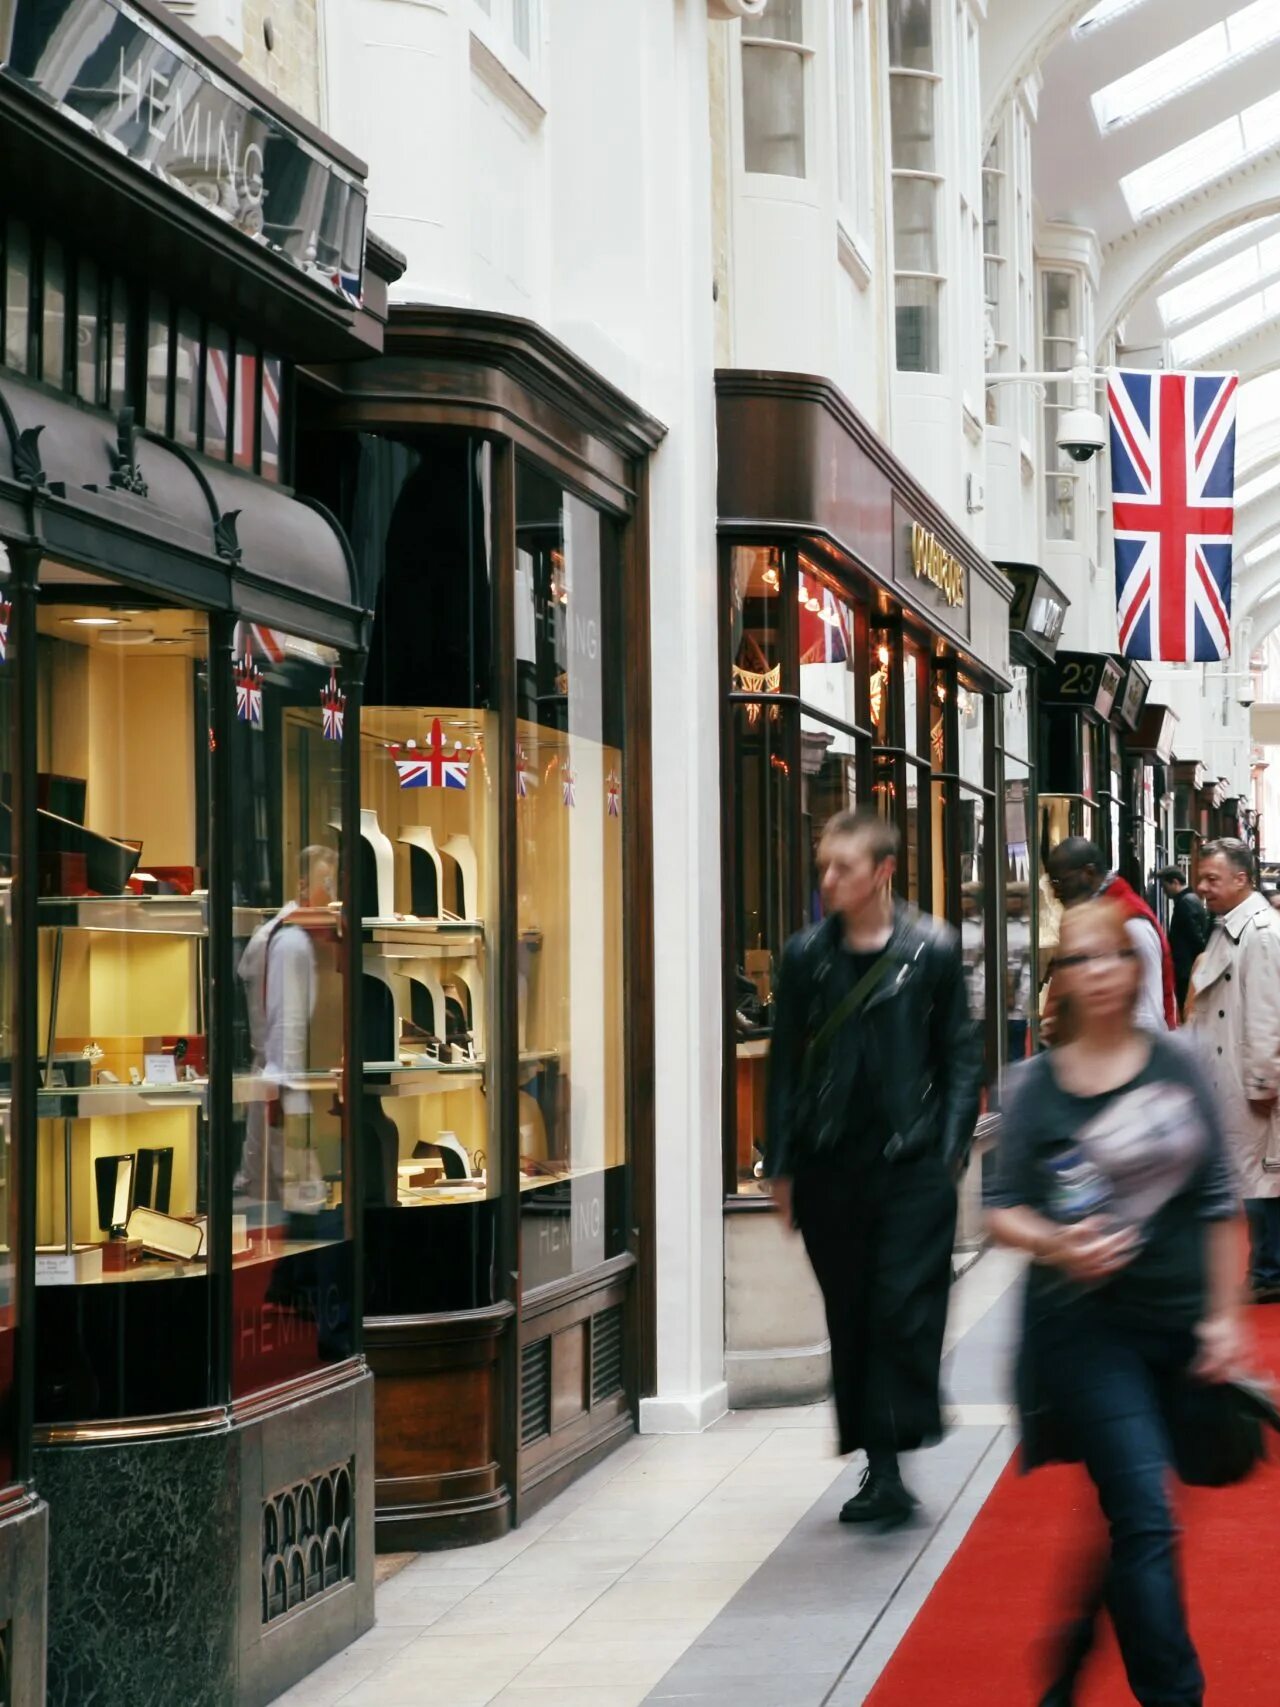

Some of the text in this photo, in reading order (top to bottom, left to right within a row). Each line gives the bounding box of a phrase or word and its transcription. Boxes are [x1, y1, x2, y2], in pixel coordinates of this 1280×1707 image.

[119, 46, 264, 203] HEMING
[1060, 662, 1096, 695] 23
[240, 1284, 340, 1359] HEMING
